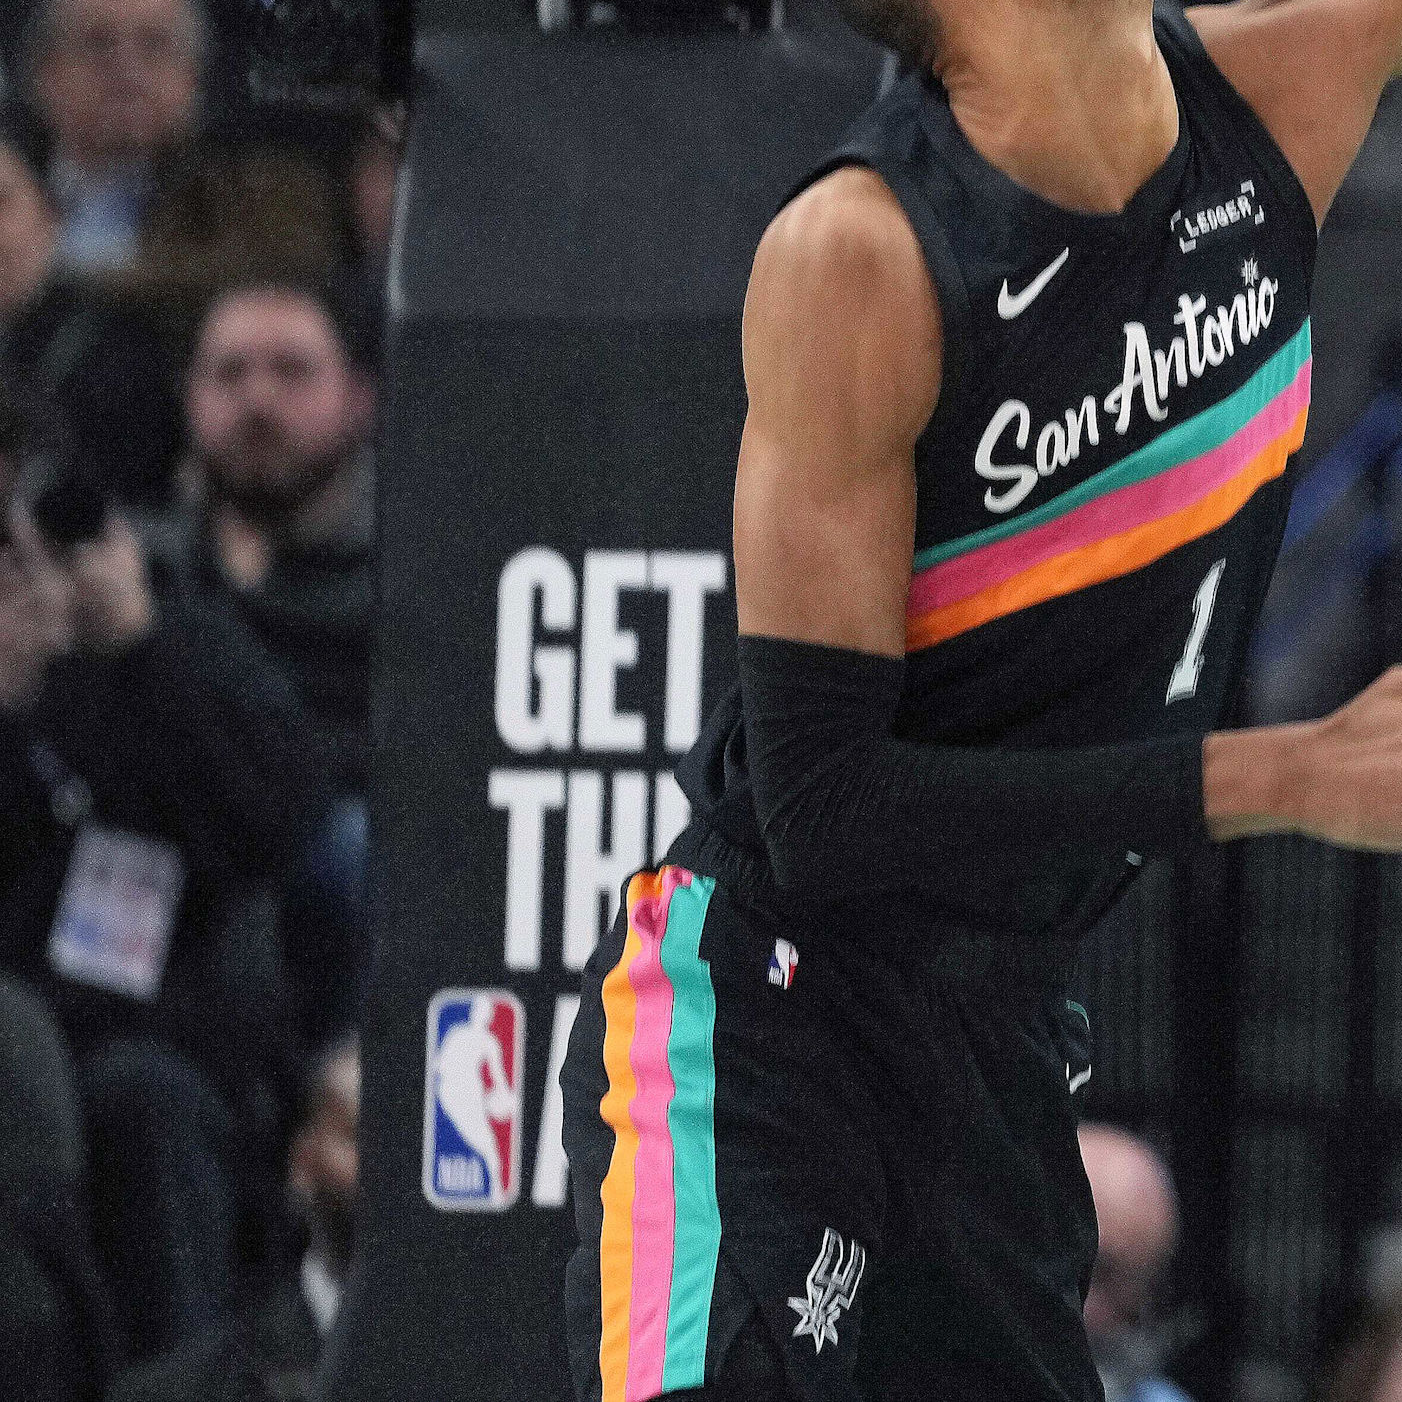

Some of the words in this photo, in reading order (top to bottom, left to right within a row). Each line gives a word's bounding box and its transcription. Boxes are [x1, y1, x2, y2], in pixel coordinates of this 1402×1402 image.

[1184, 194, 1252, 239] LEDGER
[974, 398, 1100, 513] San
[1103, 258, 1280, 435] Antonio
[494, 545, 727, 754] GET
[1165, 558, 1227, 706] 1
